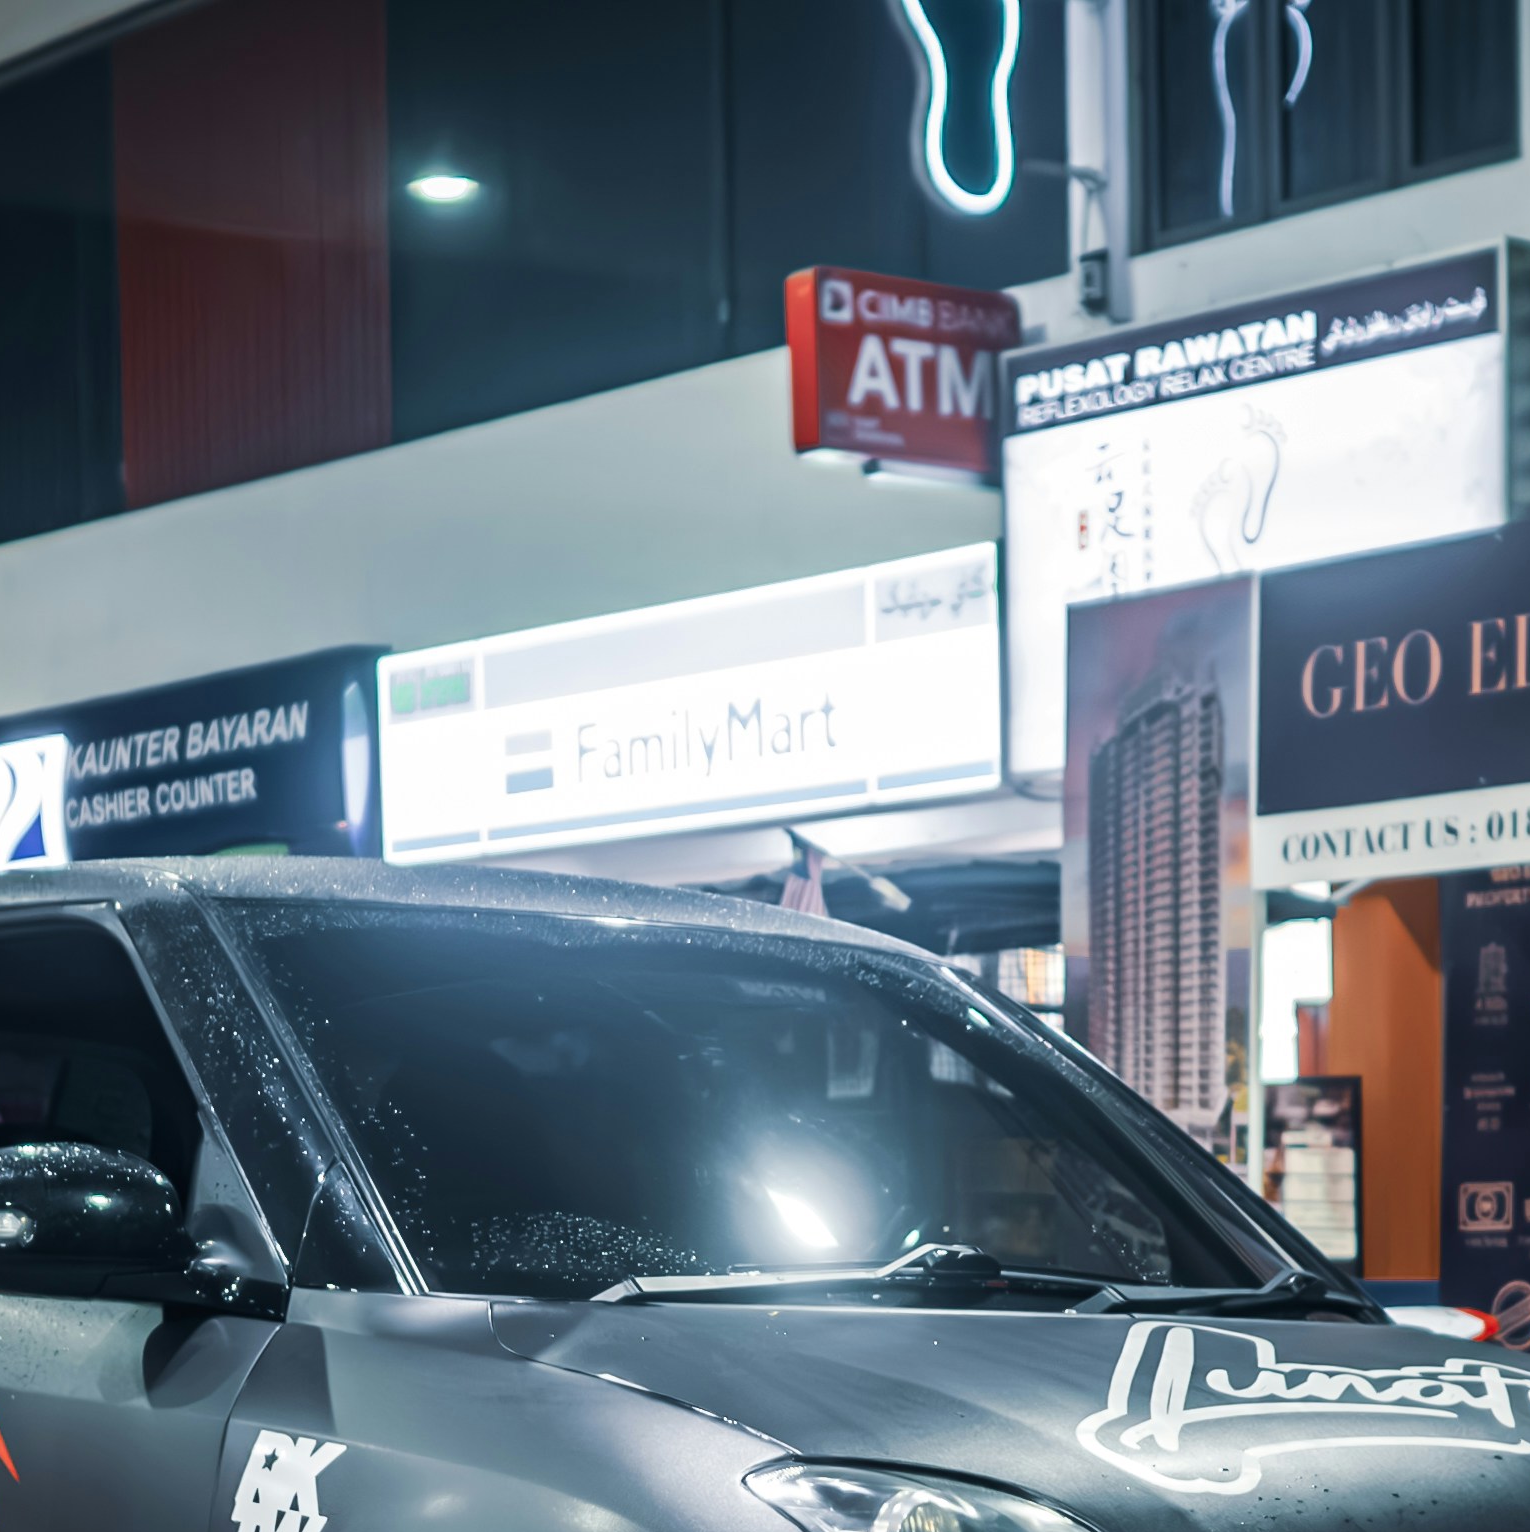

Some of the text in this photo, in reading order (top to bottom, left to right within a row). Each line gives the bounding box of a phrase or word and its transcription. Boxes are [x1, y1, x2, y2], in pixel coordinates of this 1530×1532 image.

[857, 289, 933, 328] CIMB
[846, 334, 993, 418] ATM
[1016, 353, 1130, 404] PUSAT
[1134, 310, 1317, 377] RAWATAN
[1016, 342, 1317, 427] REFLEXOLOGY RELAX CENTRE
[1301, 629, 1443, 719] GEO
[71, 702, 308, 778] KAUNTER BAYARAN
[577, 694, 839, 783] FamilyMart
[69, 769, 257, 826] CASHIER COUNTER
[1282, 822, 1414, 865] CONTACT
[1425, 815, 1460, 850] US
